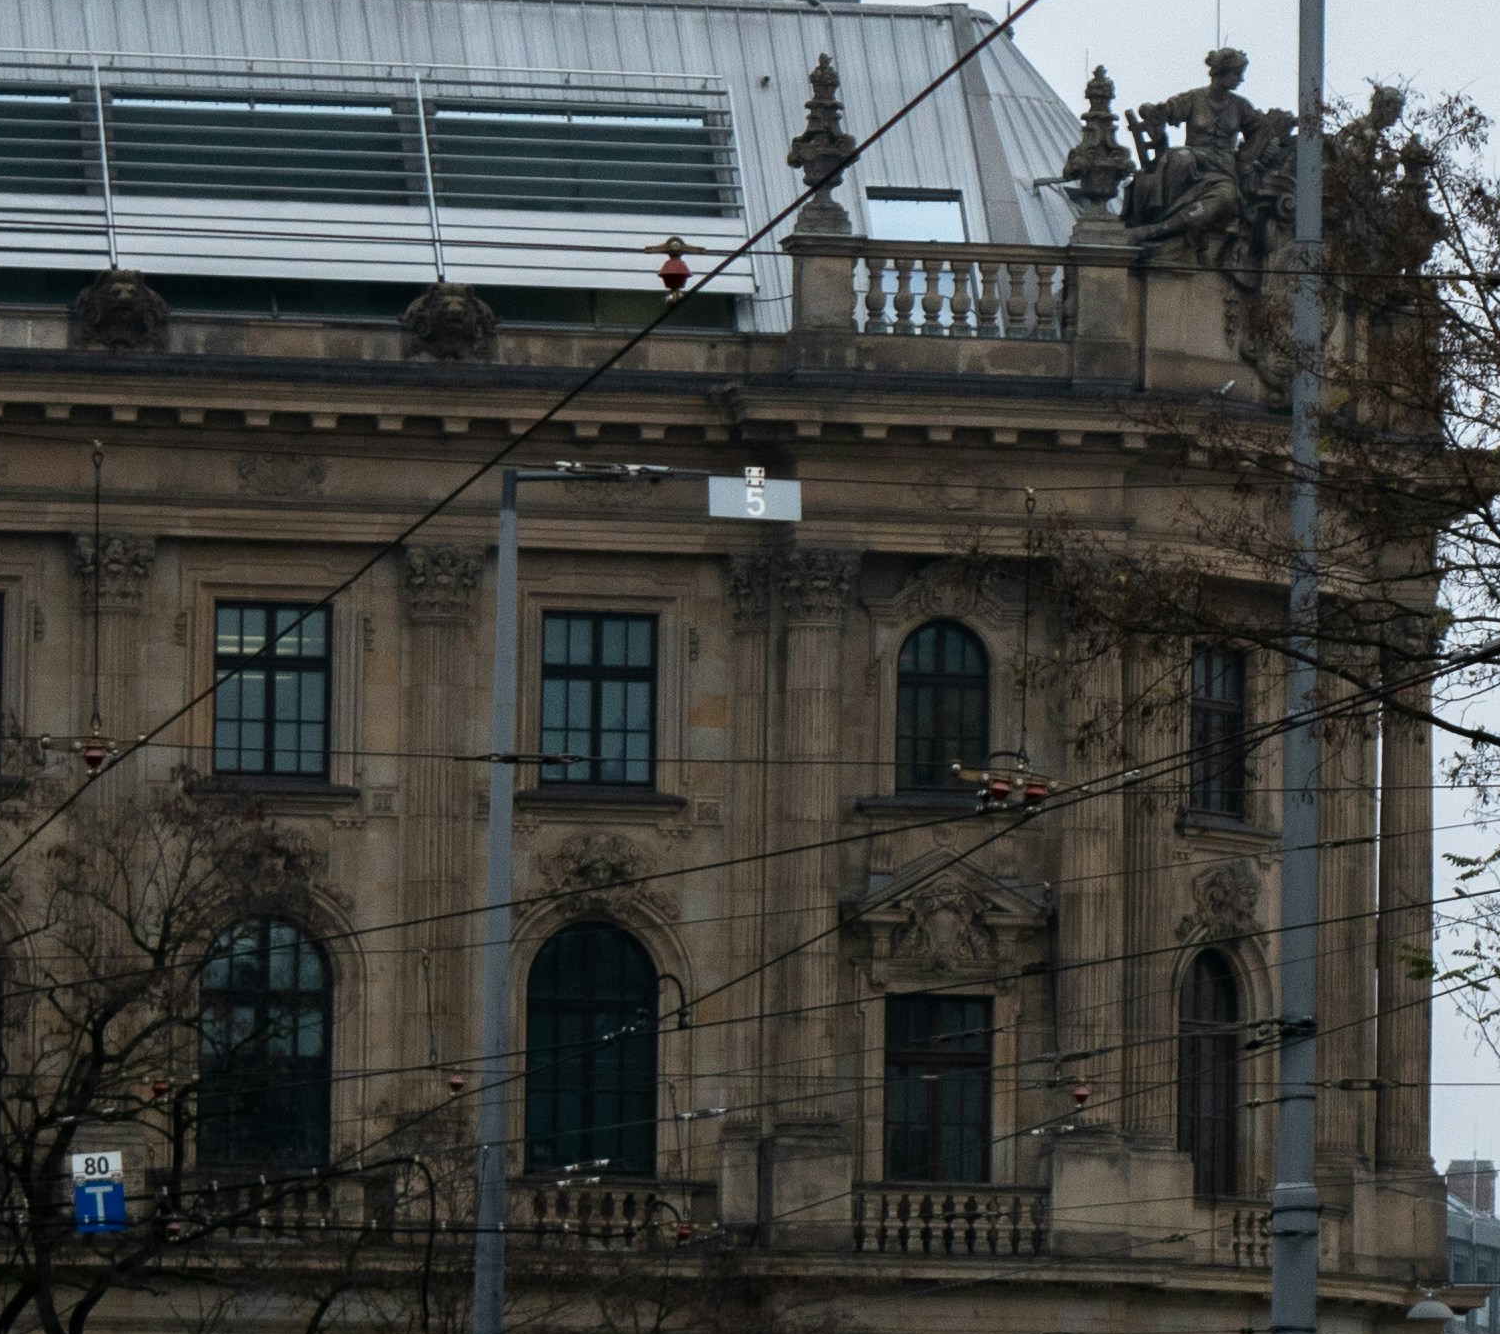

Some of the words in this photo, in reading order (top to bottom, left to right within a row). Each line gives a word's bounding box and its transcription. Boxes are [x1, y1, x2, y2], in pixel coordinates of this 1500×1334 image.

[746, 487, 766, 517] 5
[84, 1156, 110, 1176] 80
[84, 1184, 114, 1227] T
